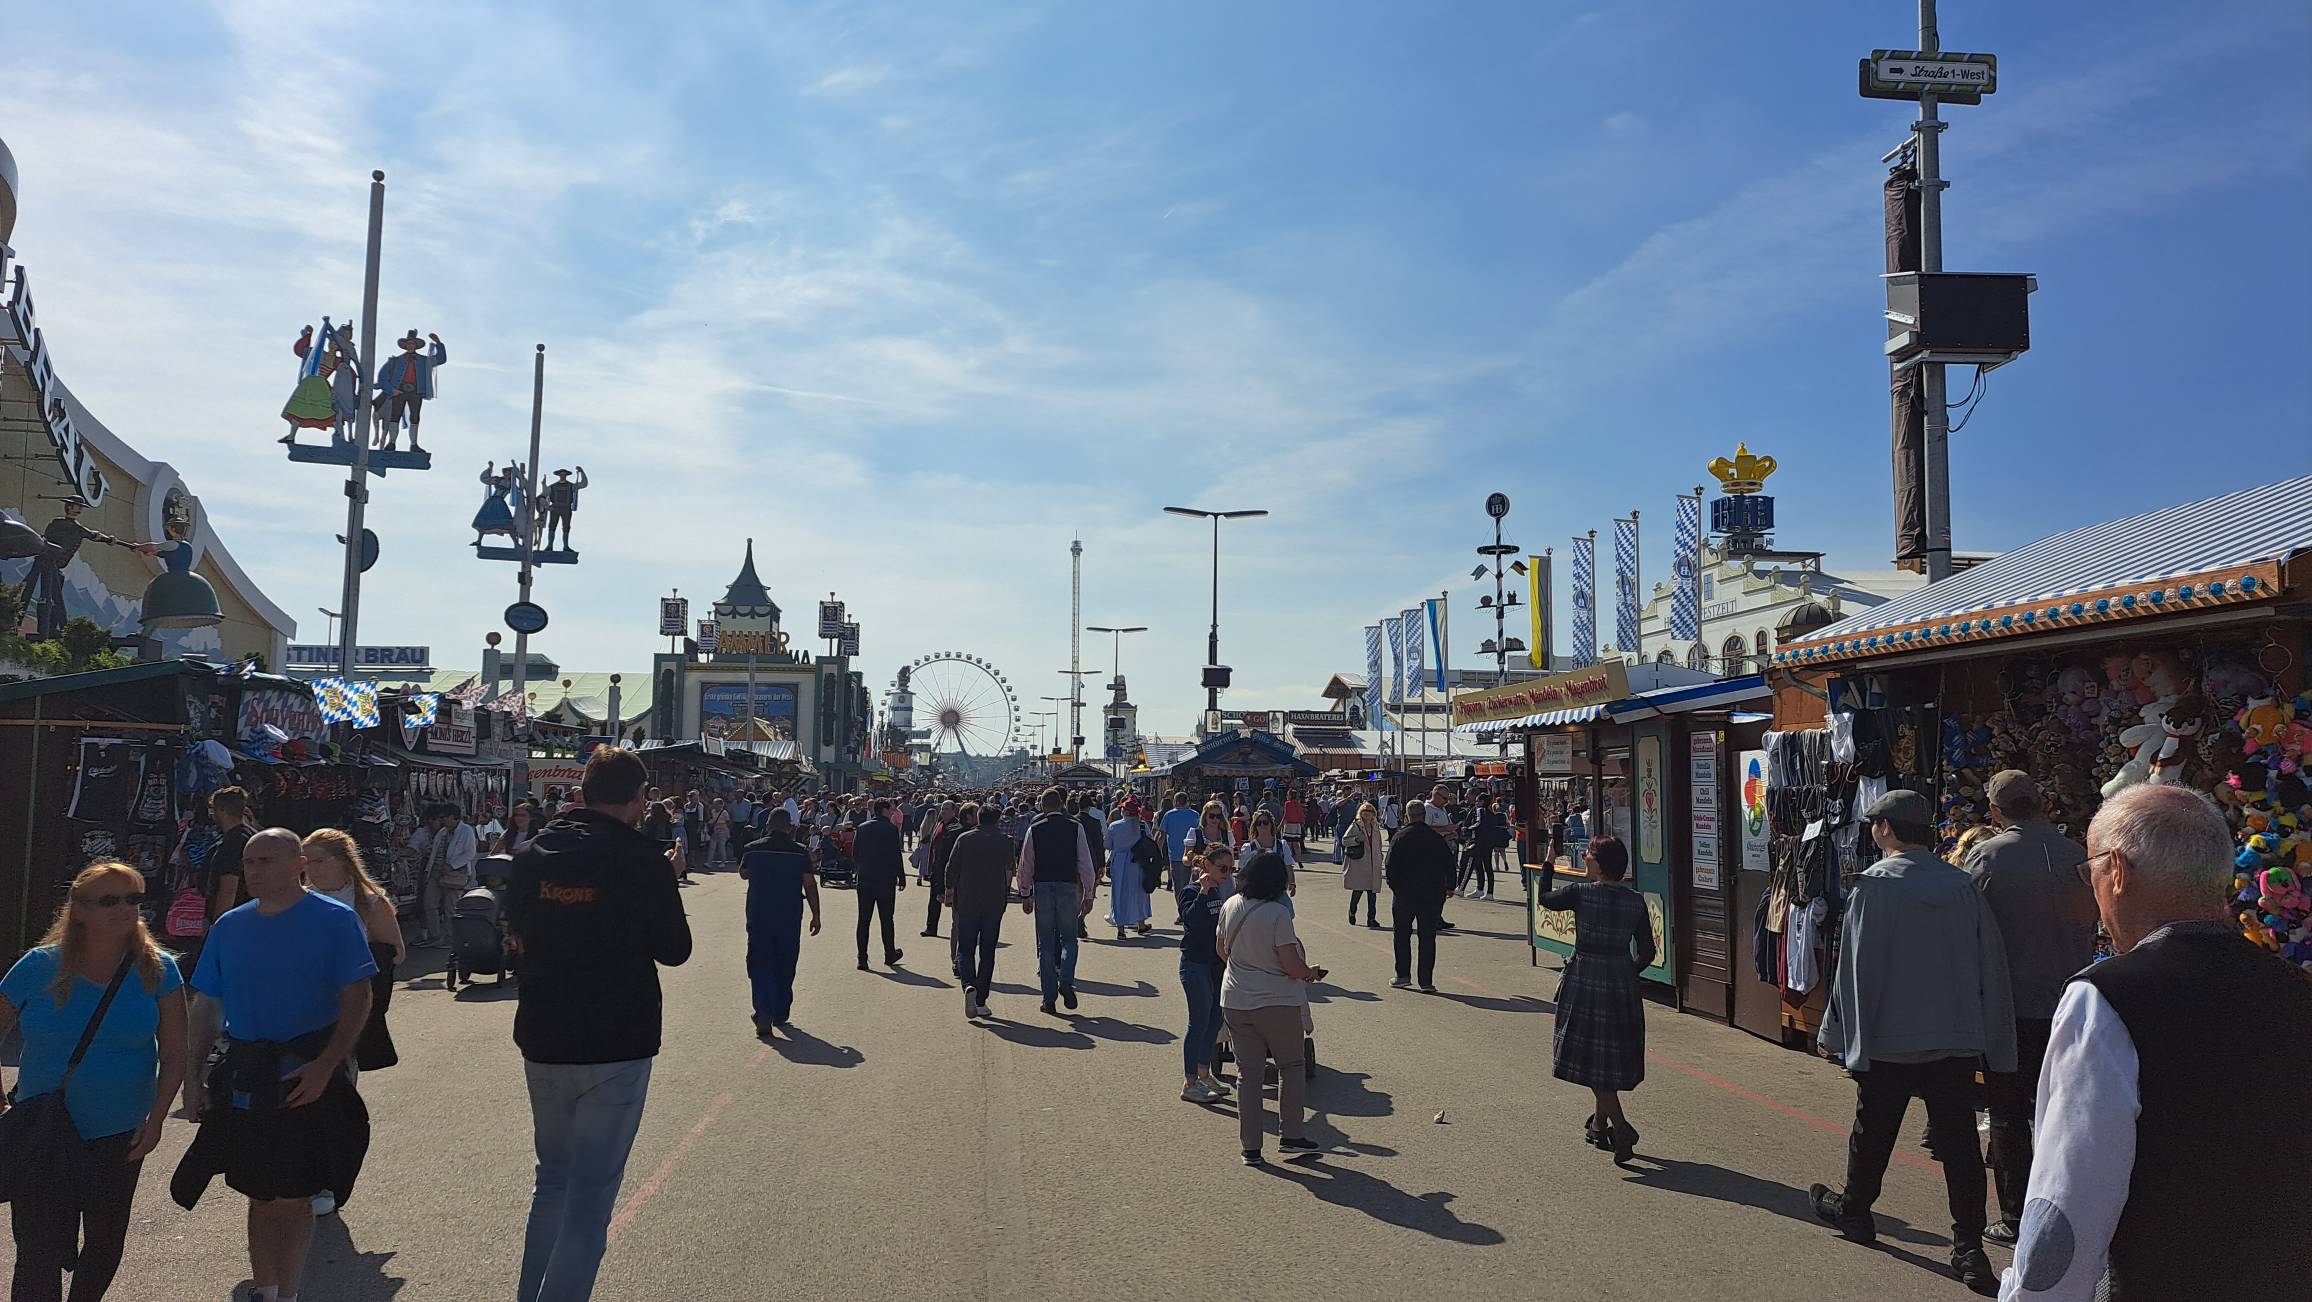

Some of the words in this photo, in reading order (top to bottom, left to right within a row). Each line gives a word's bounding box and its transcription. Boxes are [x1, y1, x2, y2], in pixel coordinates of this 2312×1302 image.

[1911, 65, 1949, 79] Straße
[1951, 69, 1985, 80] 1-West
[716, 630, 790, 655] AMMER
[365, 646, 425, 664] BRÄU
[1459, 701, 1483, 716] Popcorn
[1486, 694, 1526, 711] Zuckerwatte
[1564, 674, 1608, 698] Magenbrot
[1291, 712, 1344, 721] HAXNBRATEREI
